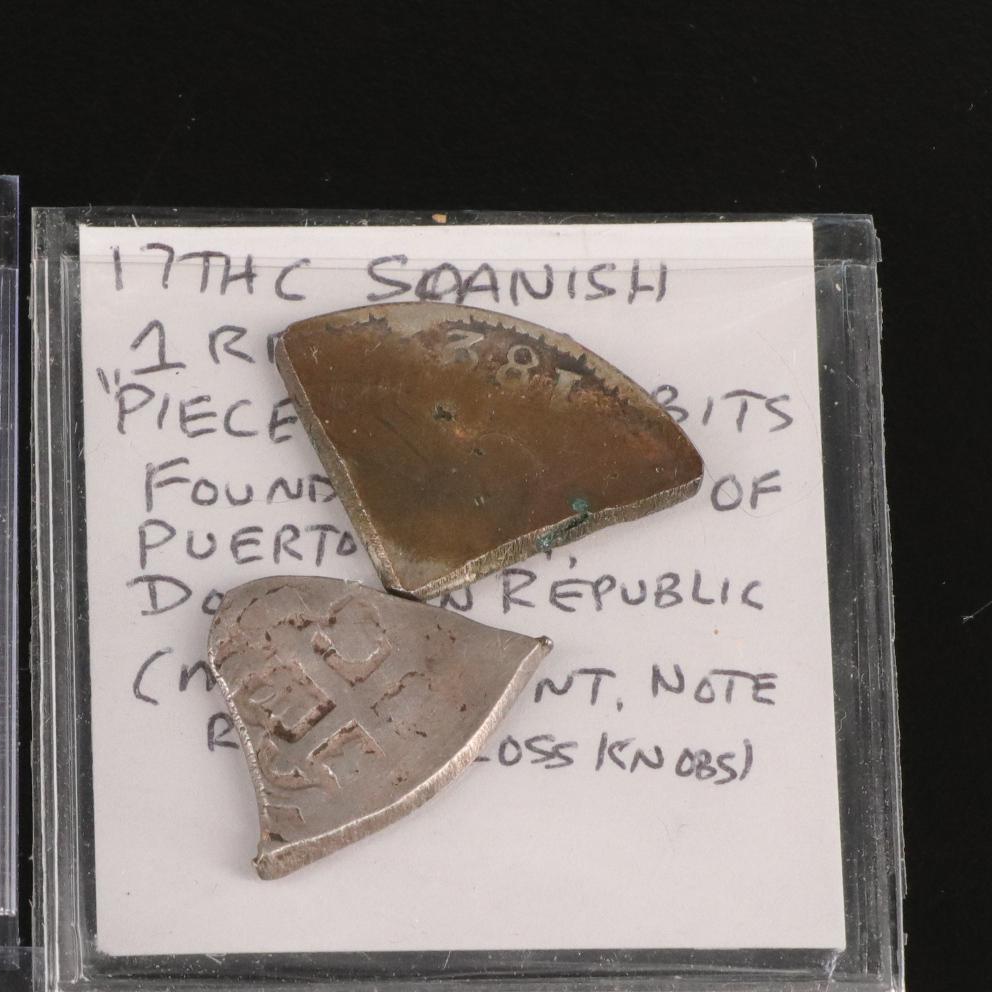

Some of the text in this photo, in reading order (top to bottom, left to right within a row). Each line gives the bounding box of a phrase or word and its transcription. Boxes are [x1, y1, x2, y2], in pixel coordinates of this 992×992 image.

[130, 319, 187, 376] 1
[709, 469, 782, 512] OF
[134, 516, 360, 572] PUERTO
[651, 664, 778, 706] NOTE
